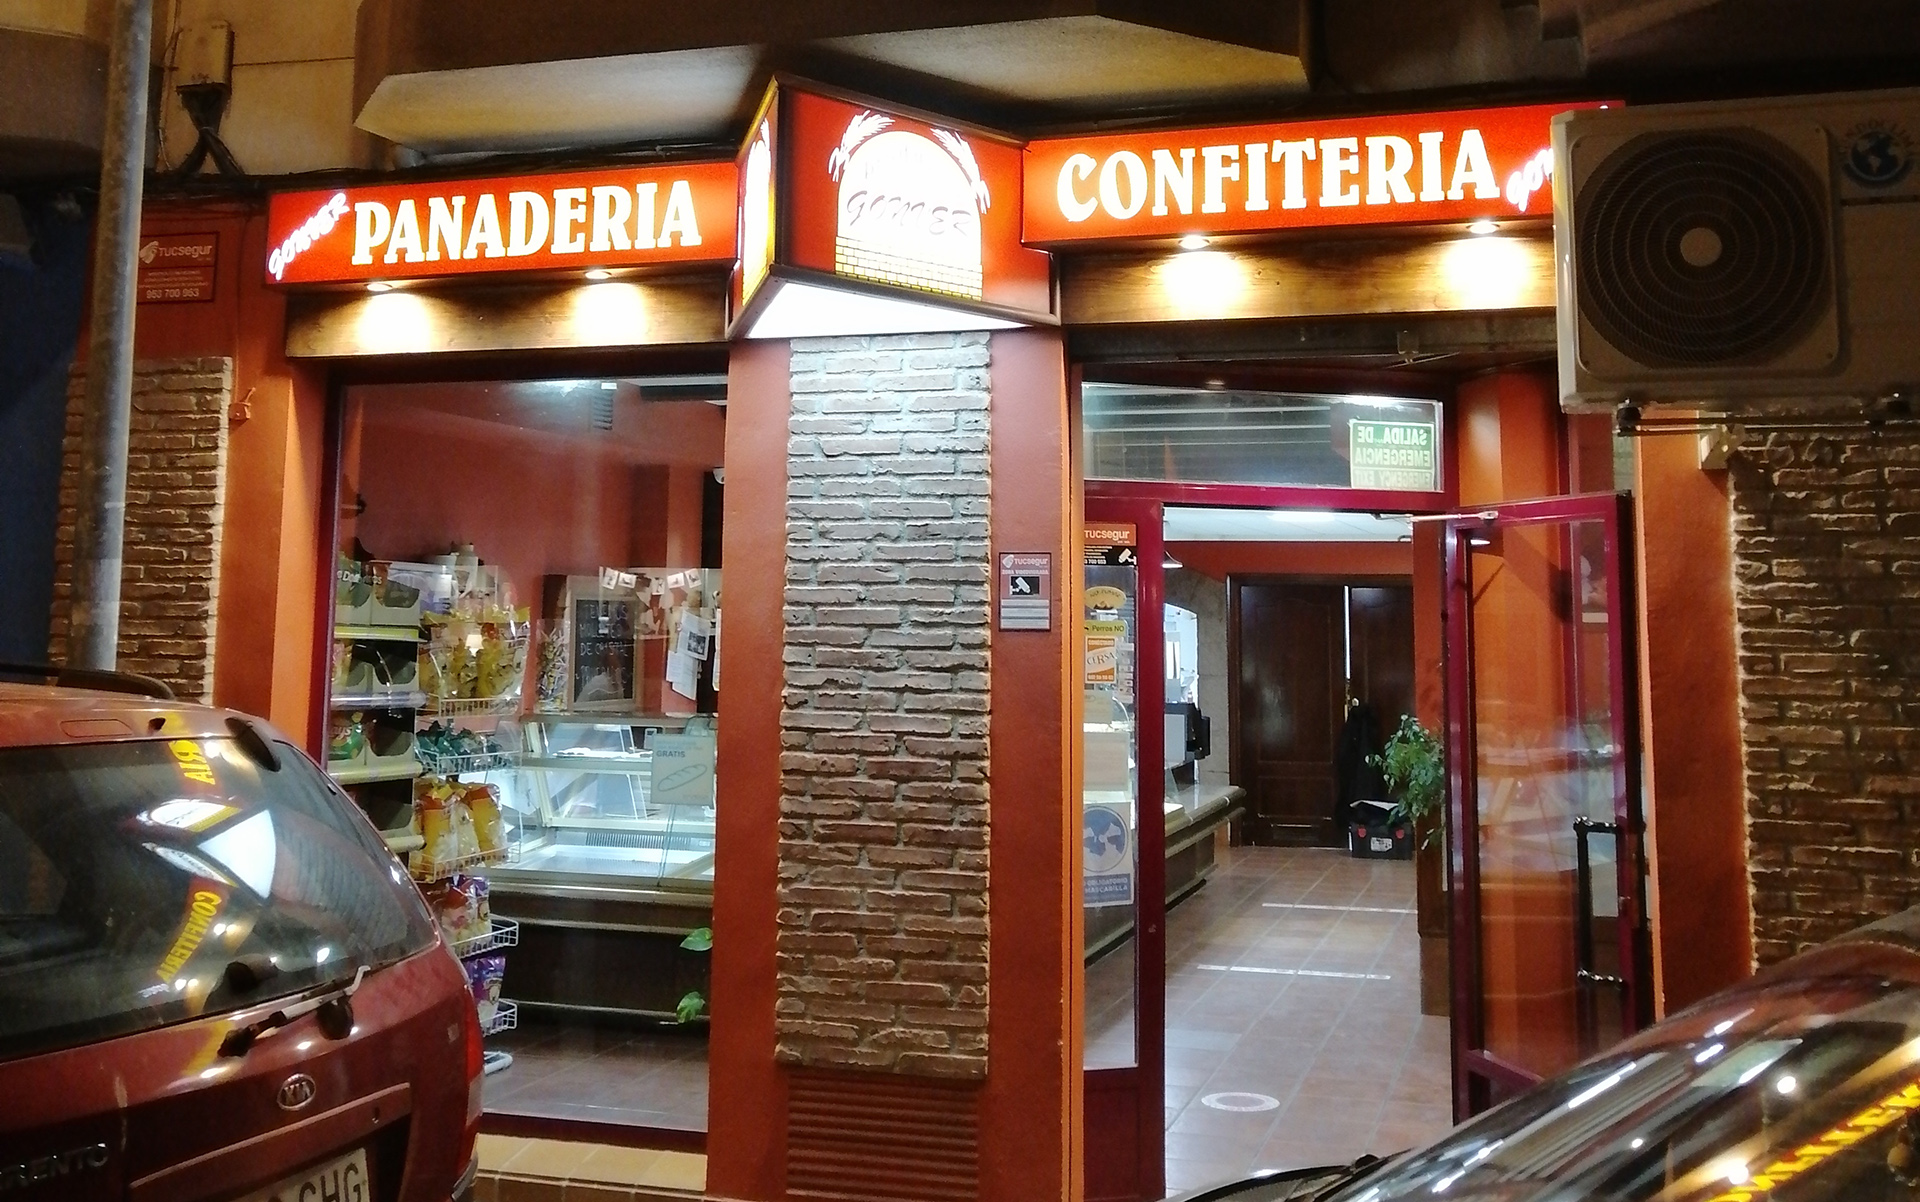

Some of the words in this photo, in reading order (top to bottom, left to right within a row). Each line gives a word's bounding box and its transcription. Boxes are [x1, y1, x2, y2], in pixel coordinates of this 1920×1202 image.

[1056, 129, 1500, 222] CONFITERIA
[351, 180, 702, 265] PANADERIA
[1114, 624, 1125, 632] NO
[656, 750, 685, 758] GRATIS
[283, 1081, 311, 1103] KIA
